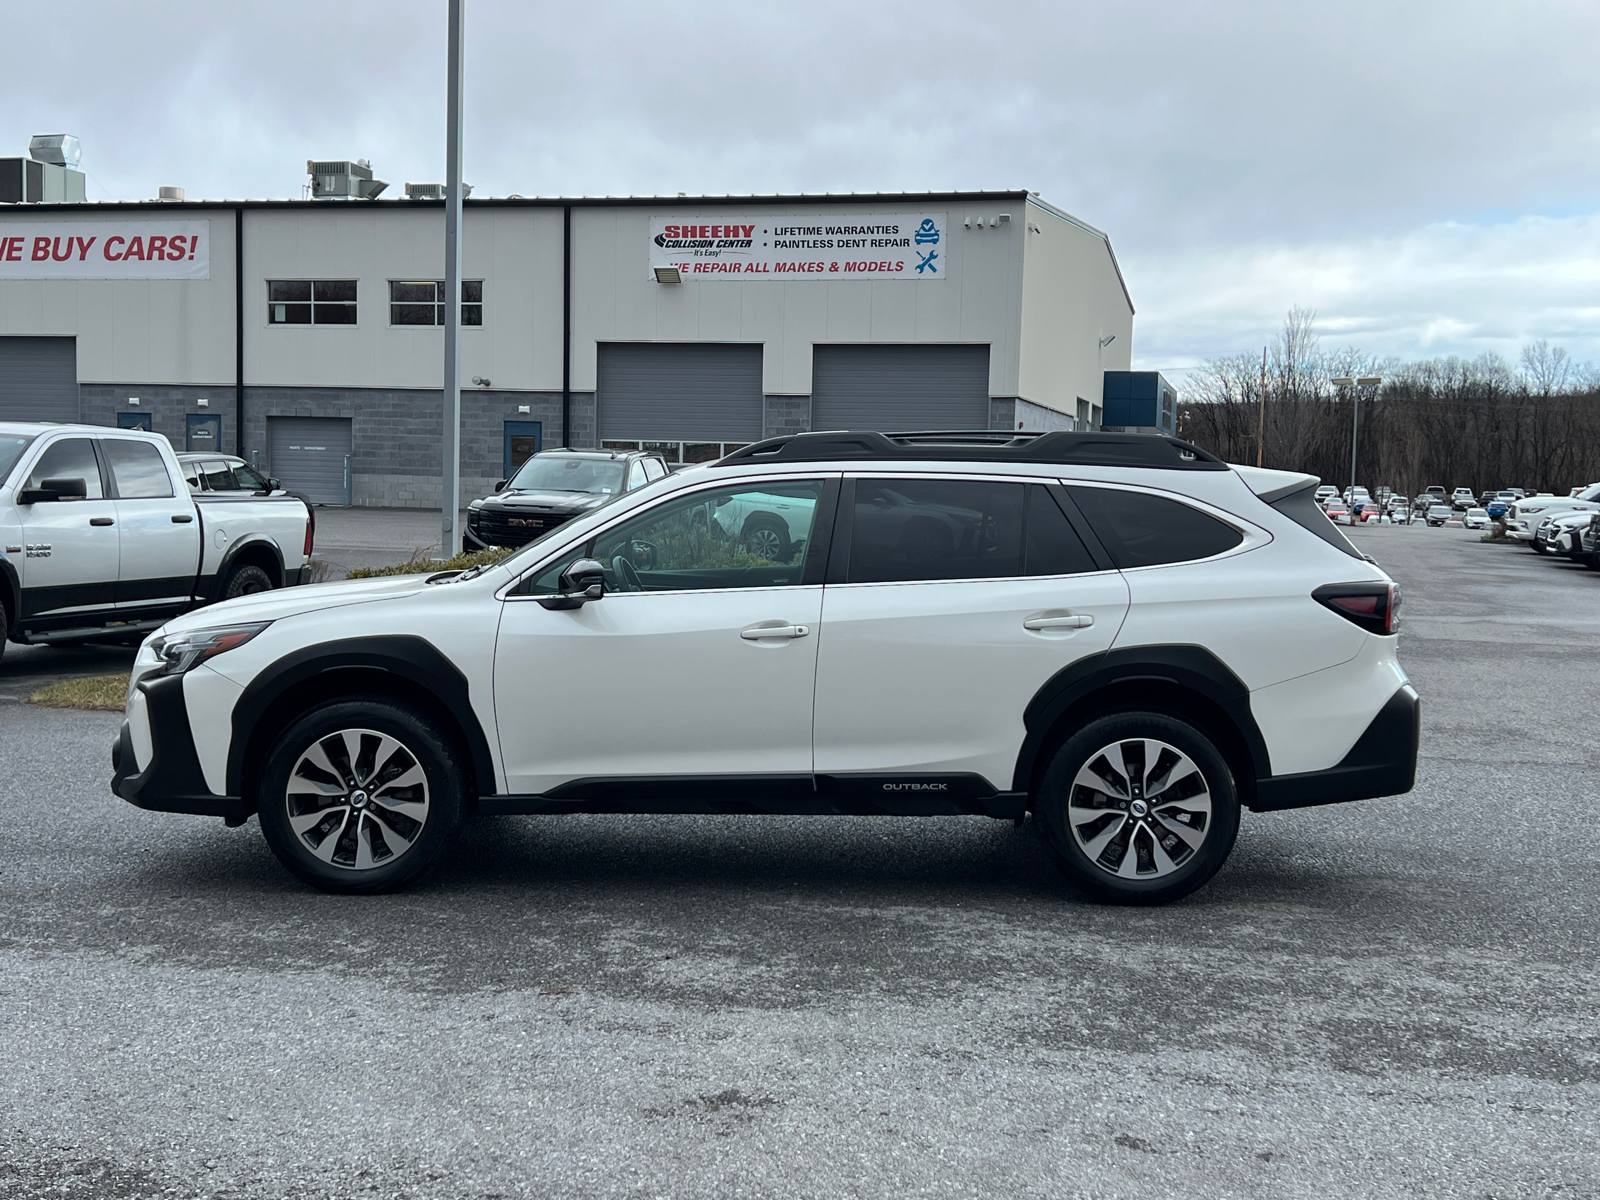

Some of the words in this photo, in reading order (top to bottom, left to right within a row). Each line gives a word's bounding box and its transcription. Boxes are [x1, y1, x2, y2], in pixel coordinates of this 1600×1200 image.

[664, 225, 755, 238] SHEEHY
[774, 227, 823, 236] LIFETIME
[825, 225, 899, 235] WARRANTIES
[31, 236, 97, 261] BUY
[103, 235, 199, 261] CARS!
[665, 240, 714, 248] COLLISION
[716, 240, 753, 248] CENTER
[774, 239, 834, 249] PAINTLESS
[837, 239, 867, 248] DENT
[870, 238, 910, 248] REPAIR
[694, 249, 704, 257] It's
[705, 249, 722, 258] Easy!
[693, 263, 742, 273] REPAIR
[744, 262, 770, 273] ALL
[774, 262, 825, 273] MAKES
[828, 262, 840, 272] &
[844, 261, 904, 272] MODELS
[507, 518, 544, 528] GMC
[26, 550, 52, 558] 1500
[882, 783, 948, 791] OUTBACK
